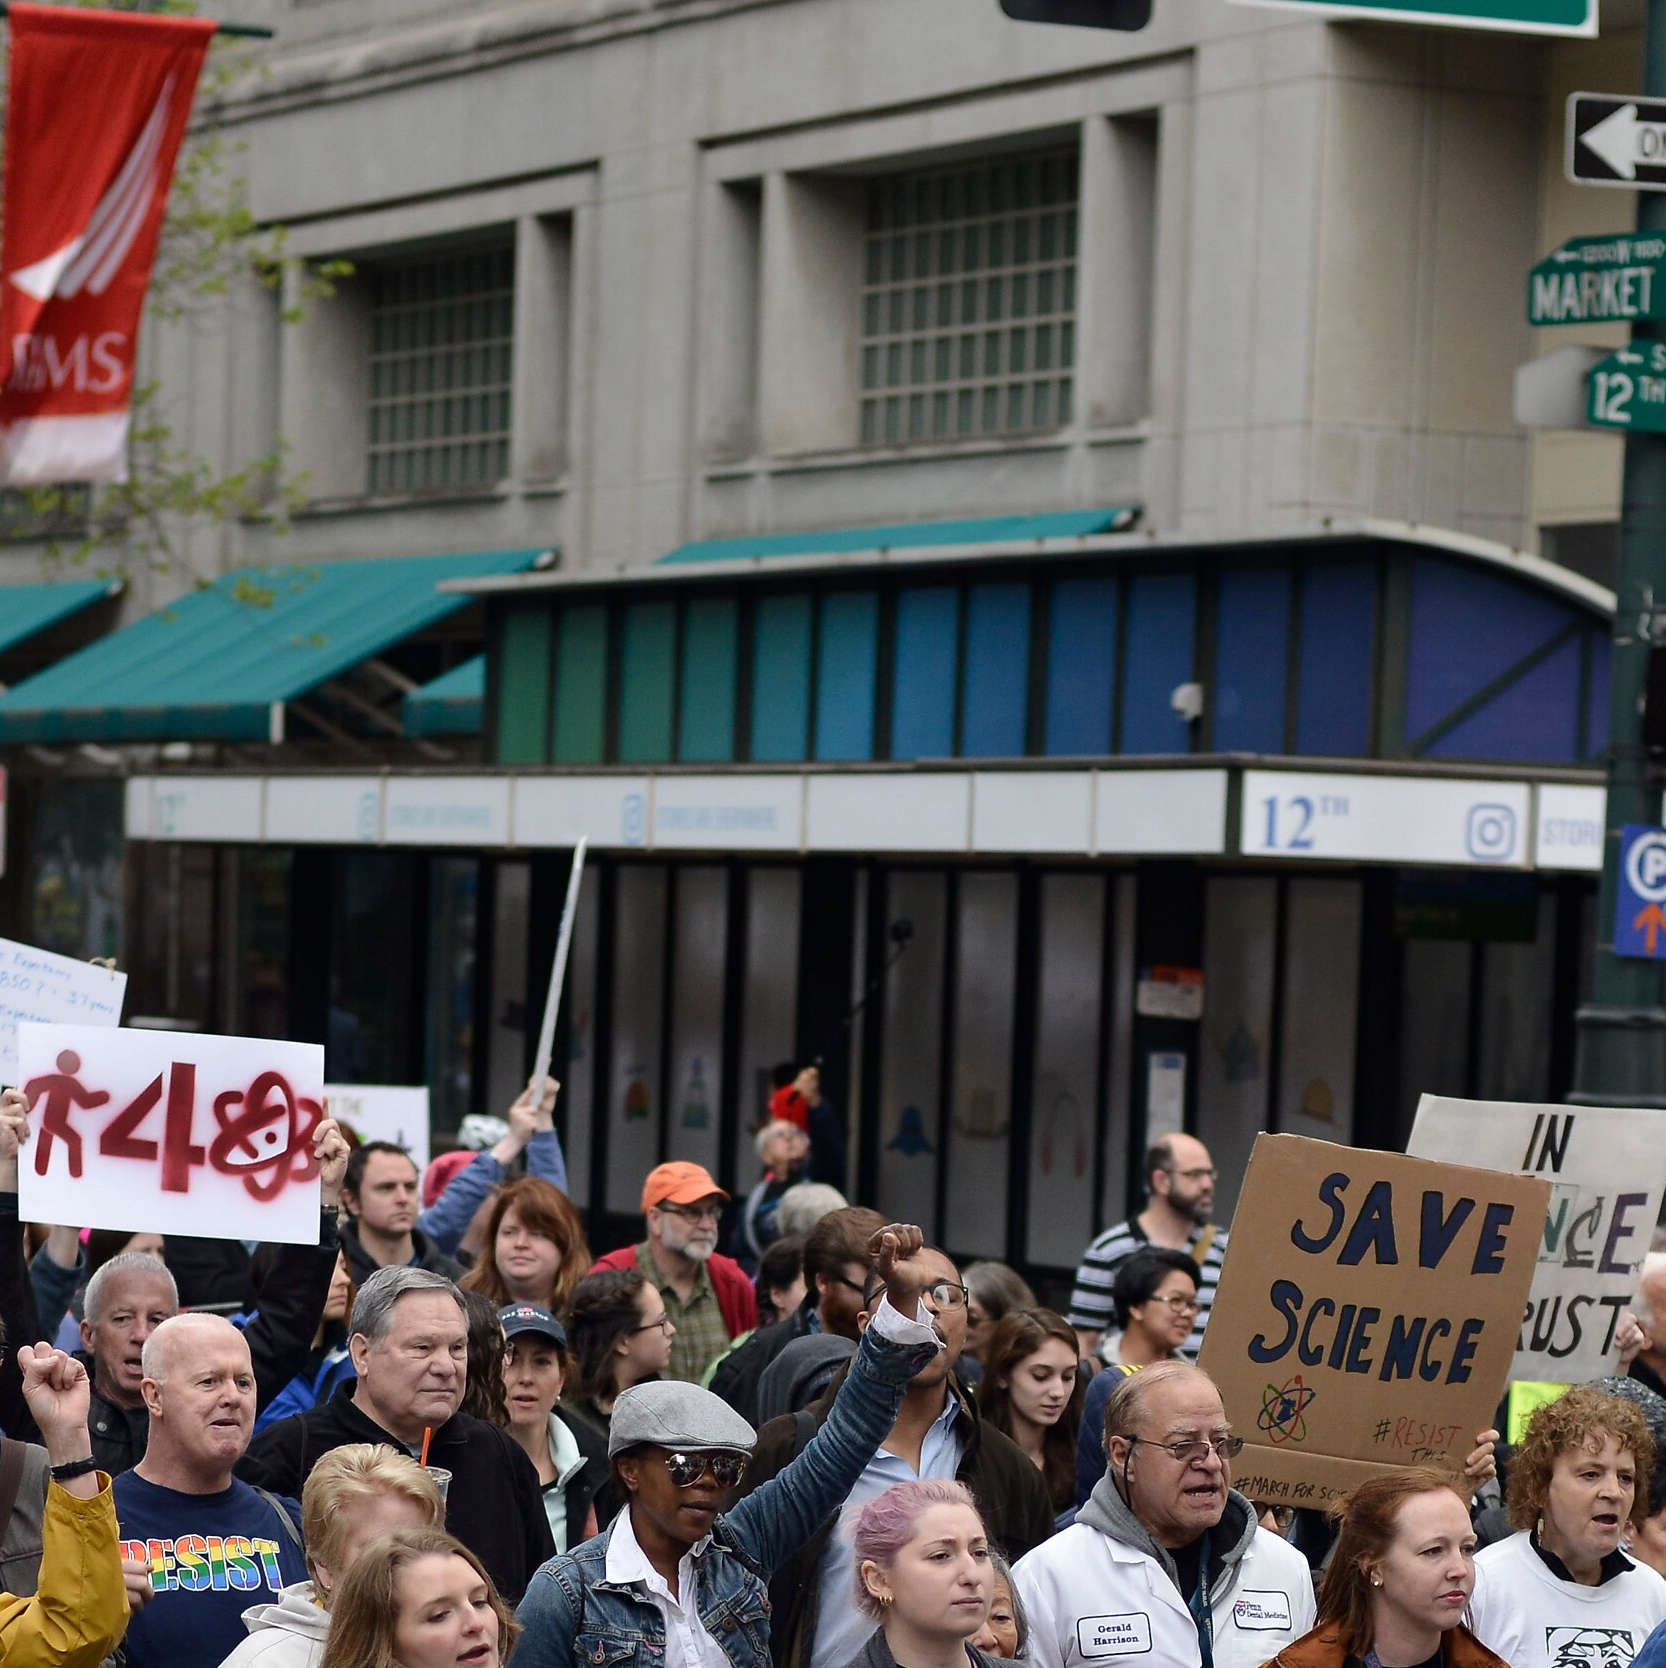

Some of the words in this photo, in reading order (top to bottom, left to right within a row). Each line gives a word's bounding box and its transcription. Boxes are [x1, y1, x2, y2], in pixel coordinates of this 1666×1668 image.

[1532, 265, 1655, 321] MARKET
[1522, 1113, 1575, 1173] IN
[1291, 1172, 1515, 1276] SAVE
[1249, 1279, 1485, 1386] SCIENCE
[1373, 1416, 1463, 1449] #RESIST
[1411, 1447, 1445, 1462] THIS
[1234, 1476, 1291, 1498] #MARCH
[1292, 1481, 1315, 1499] FOR
[1093, 1635, 1140, 1646] Harrison
[1097, 1623, 1132, 1634] Gerald
